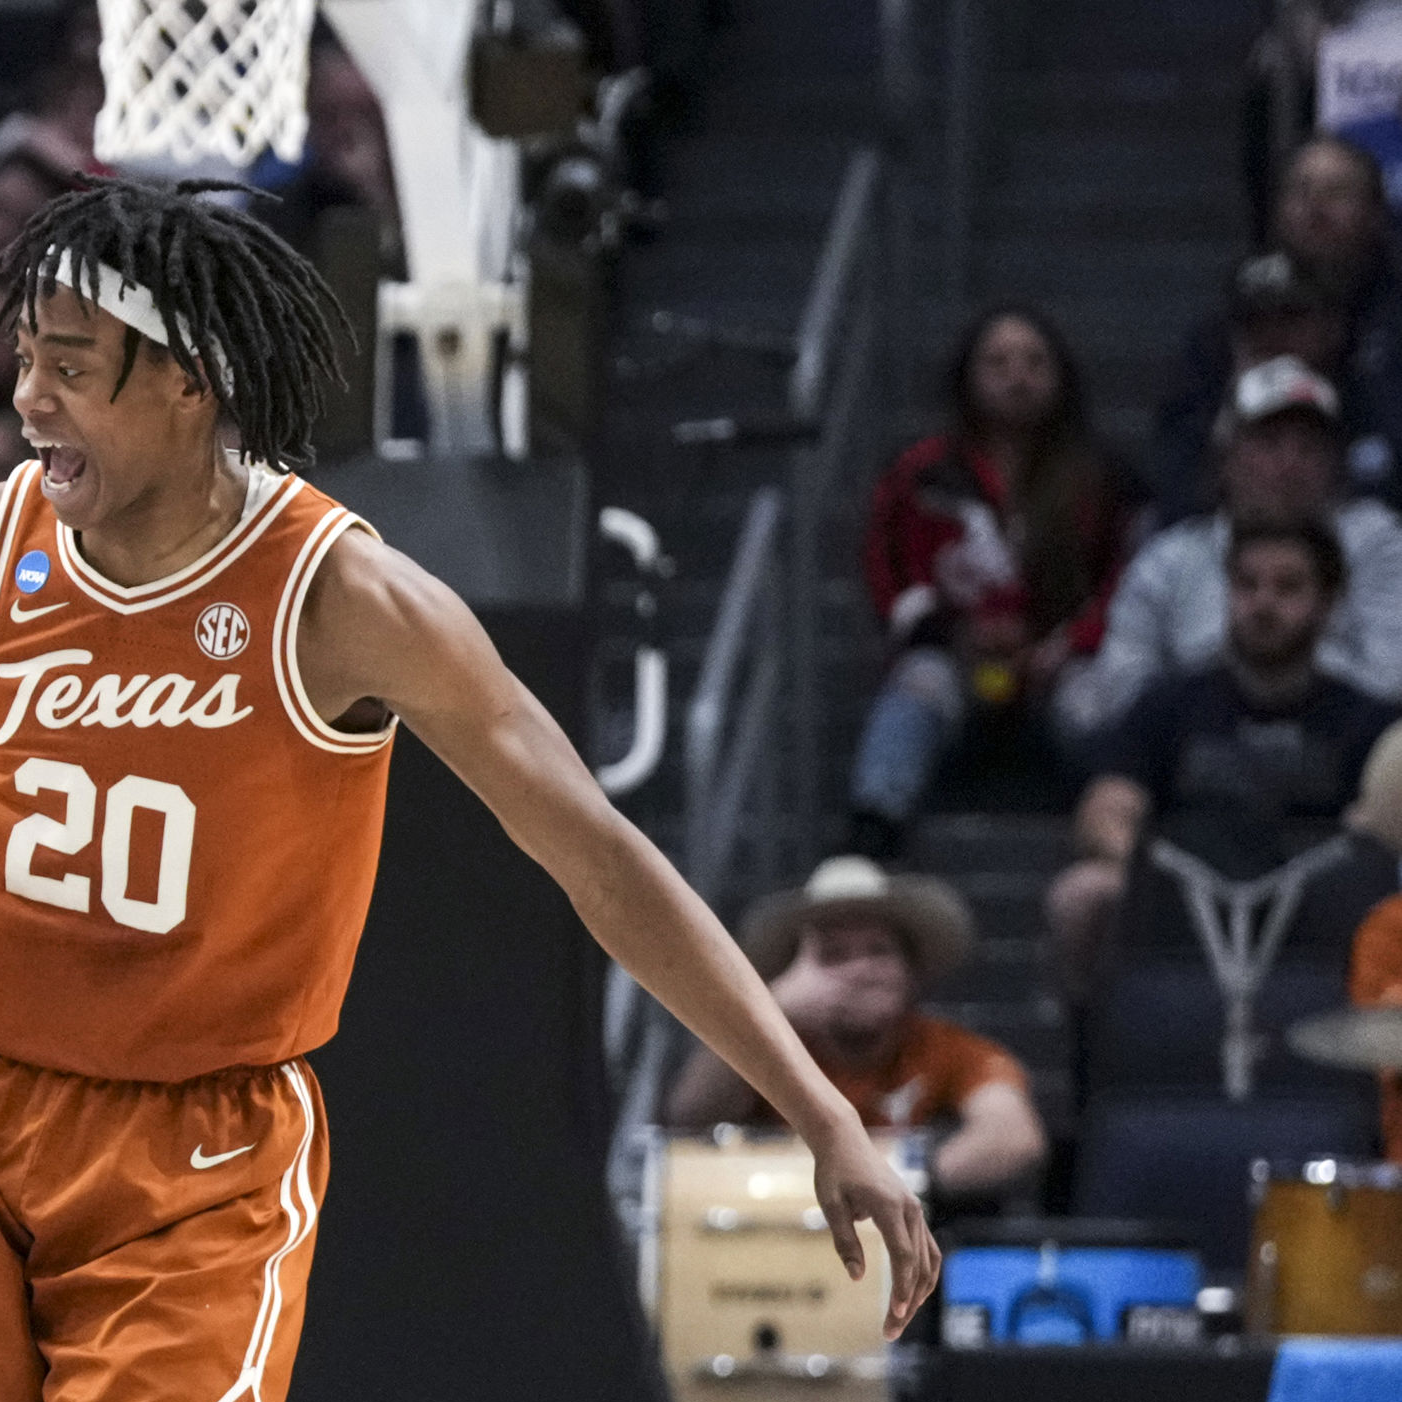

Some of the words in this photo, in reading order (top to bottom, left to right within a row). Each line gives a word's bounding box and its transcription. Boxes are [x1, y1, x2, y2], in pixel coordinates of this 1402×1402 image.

[18, 569, 46, 584] NCAA
[199, 605, 246, 657] SEC
[4, 757, 197, 935] 20
